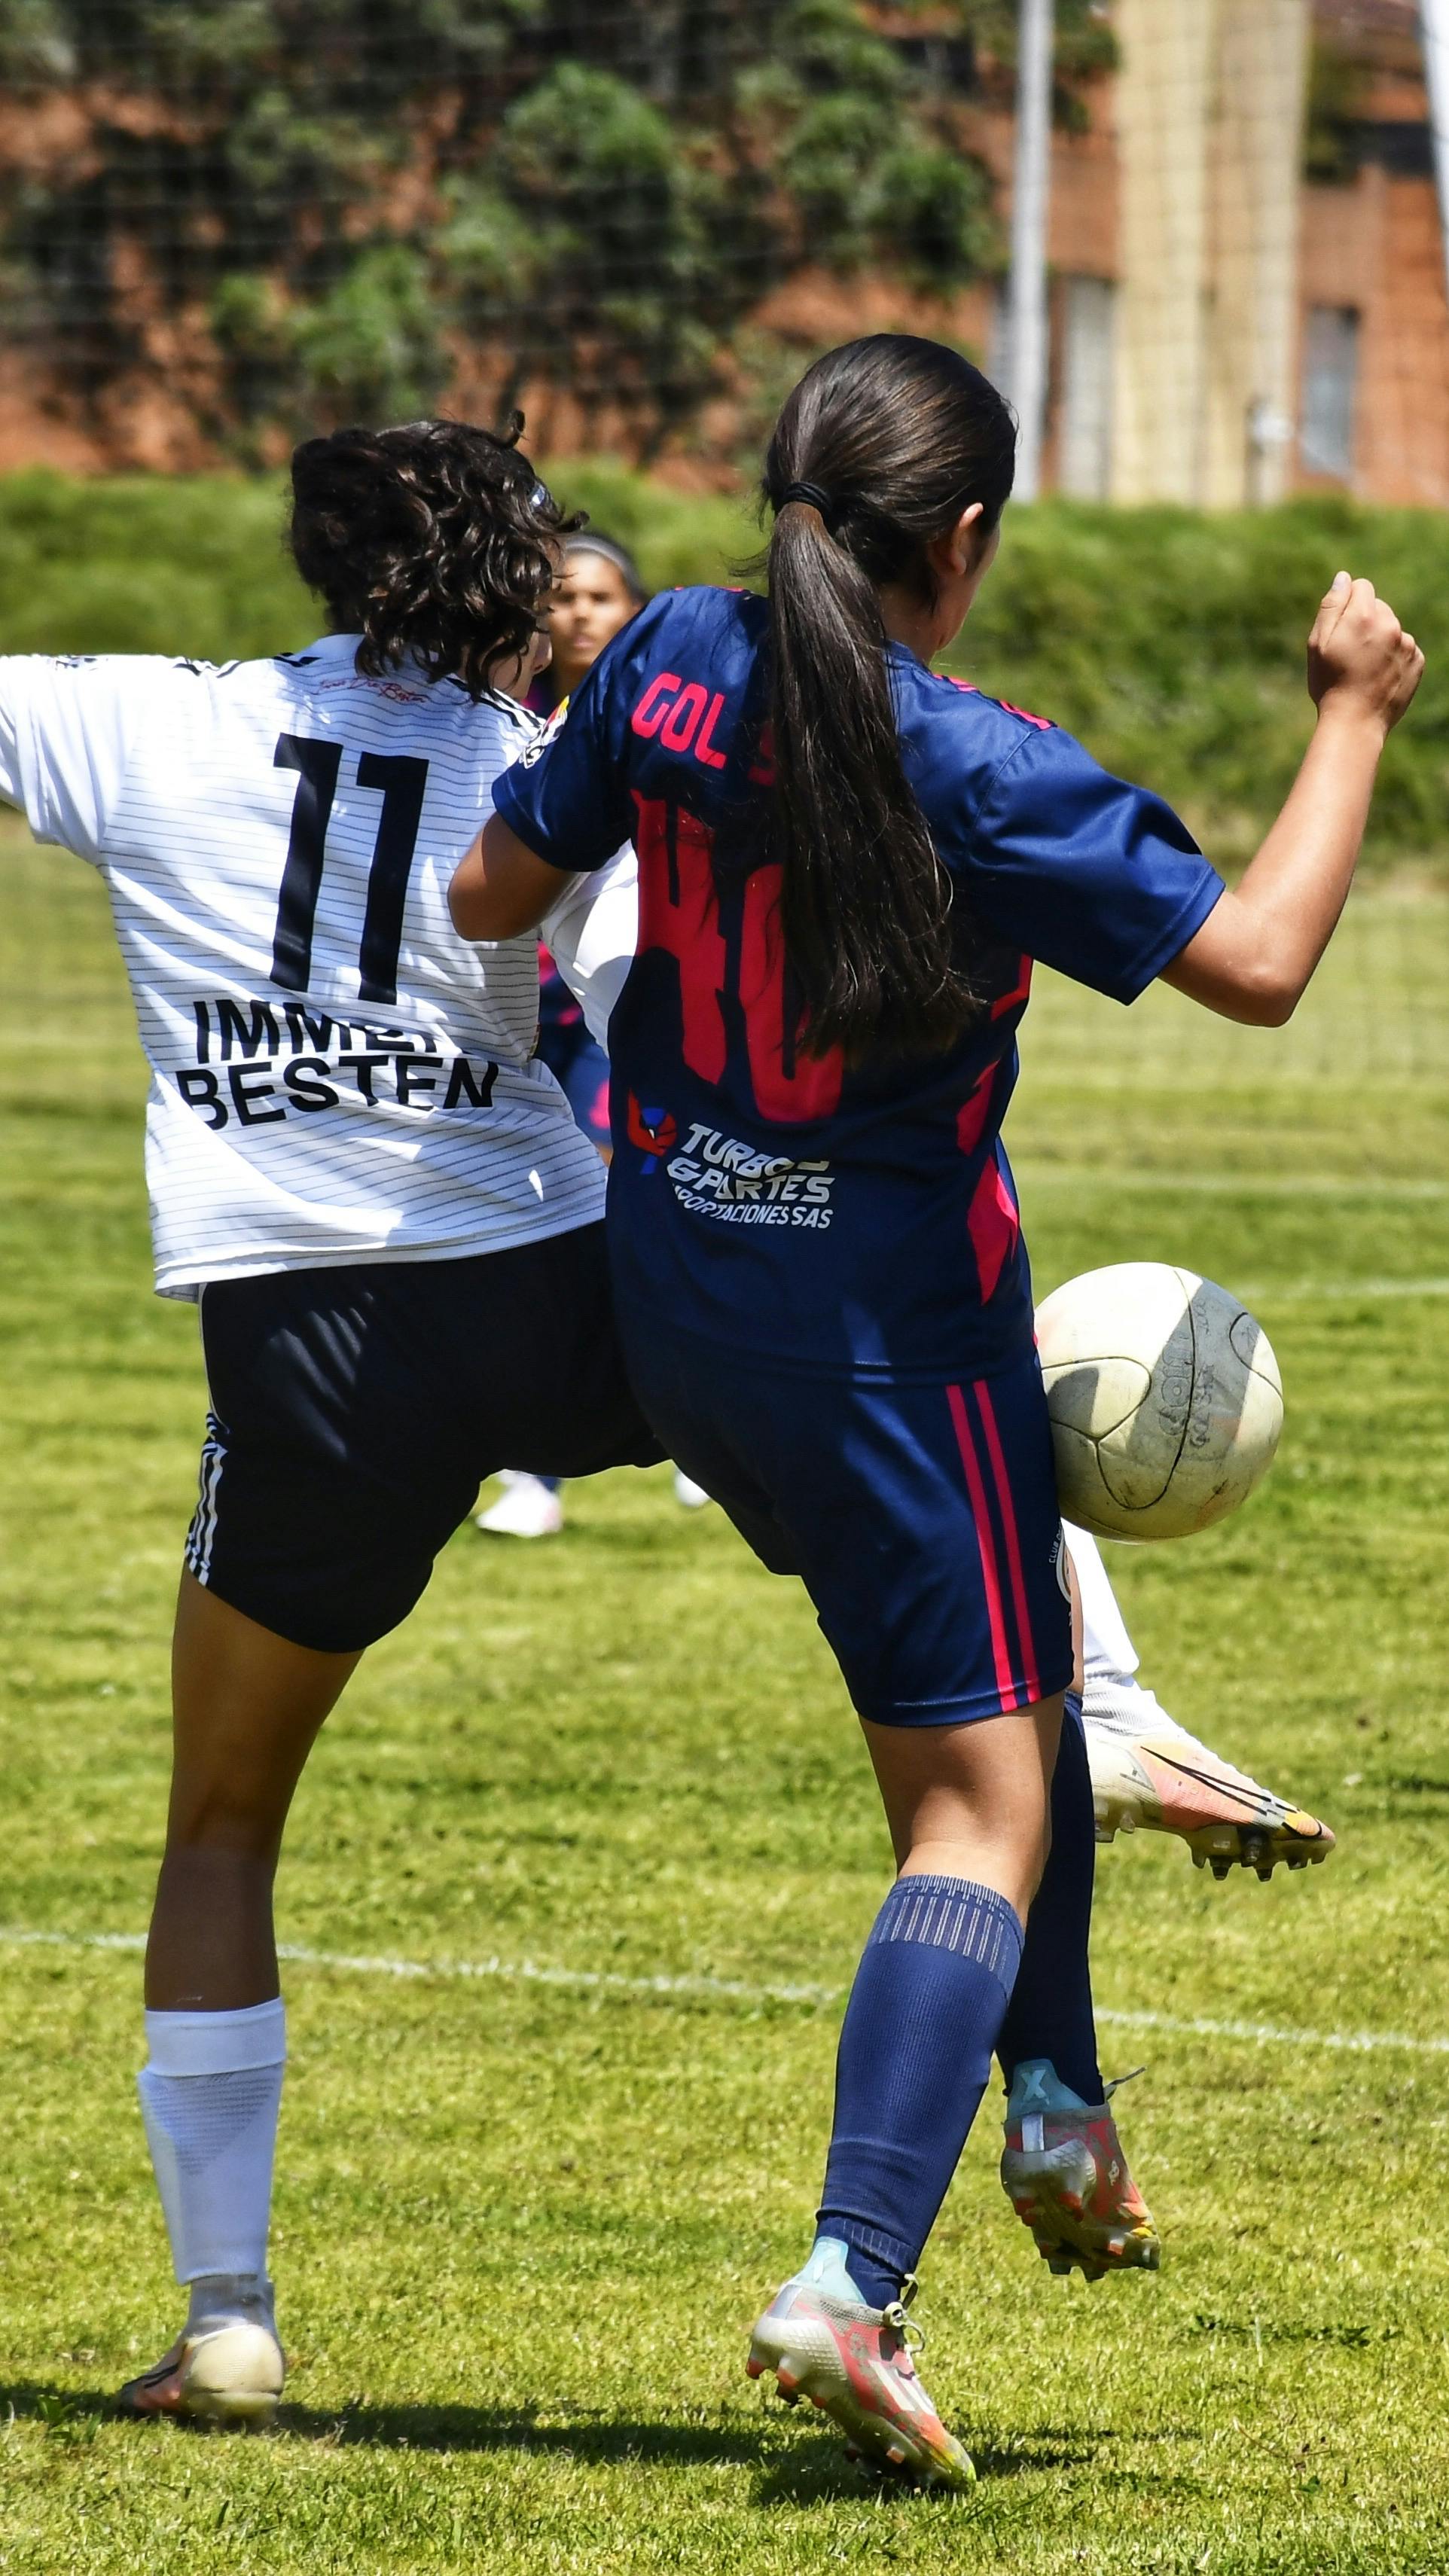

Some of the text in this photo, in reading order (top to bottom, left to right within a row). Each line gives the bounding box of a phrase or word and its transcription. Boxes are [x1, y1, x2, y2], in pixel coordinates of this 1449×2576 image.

[631, 672, 728, 770] GOL
[270, 733, 429, 1005] 11
[193, 999, 437, 1064] IMME
[175, 1055, 499, 1130] BESTEN
[673, 1183, 834, 1229] PORTACIONES SAS
